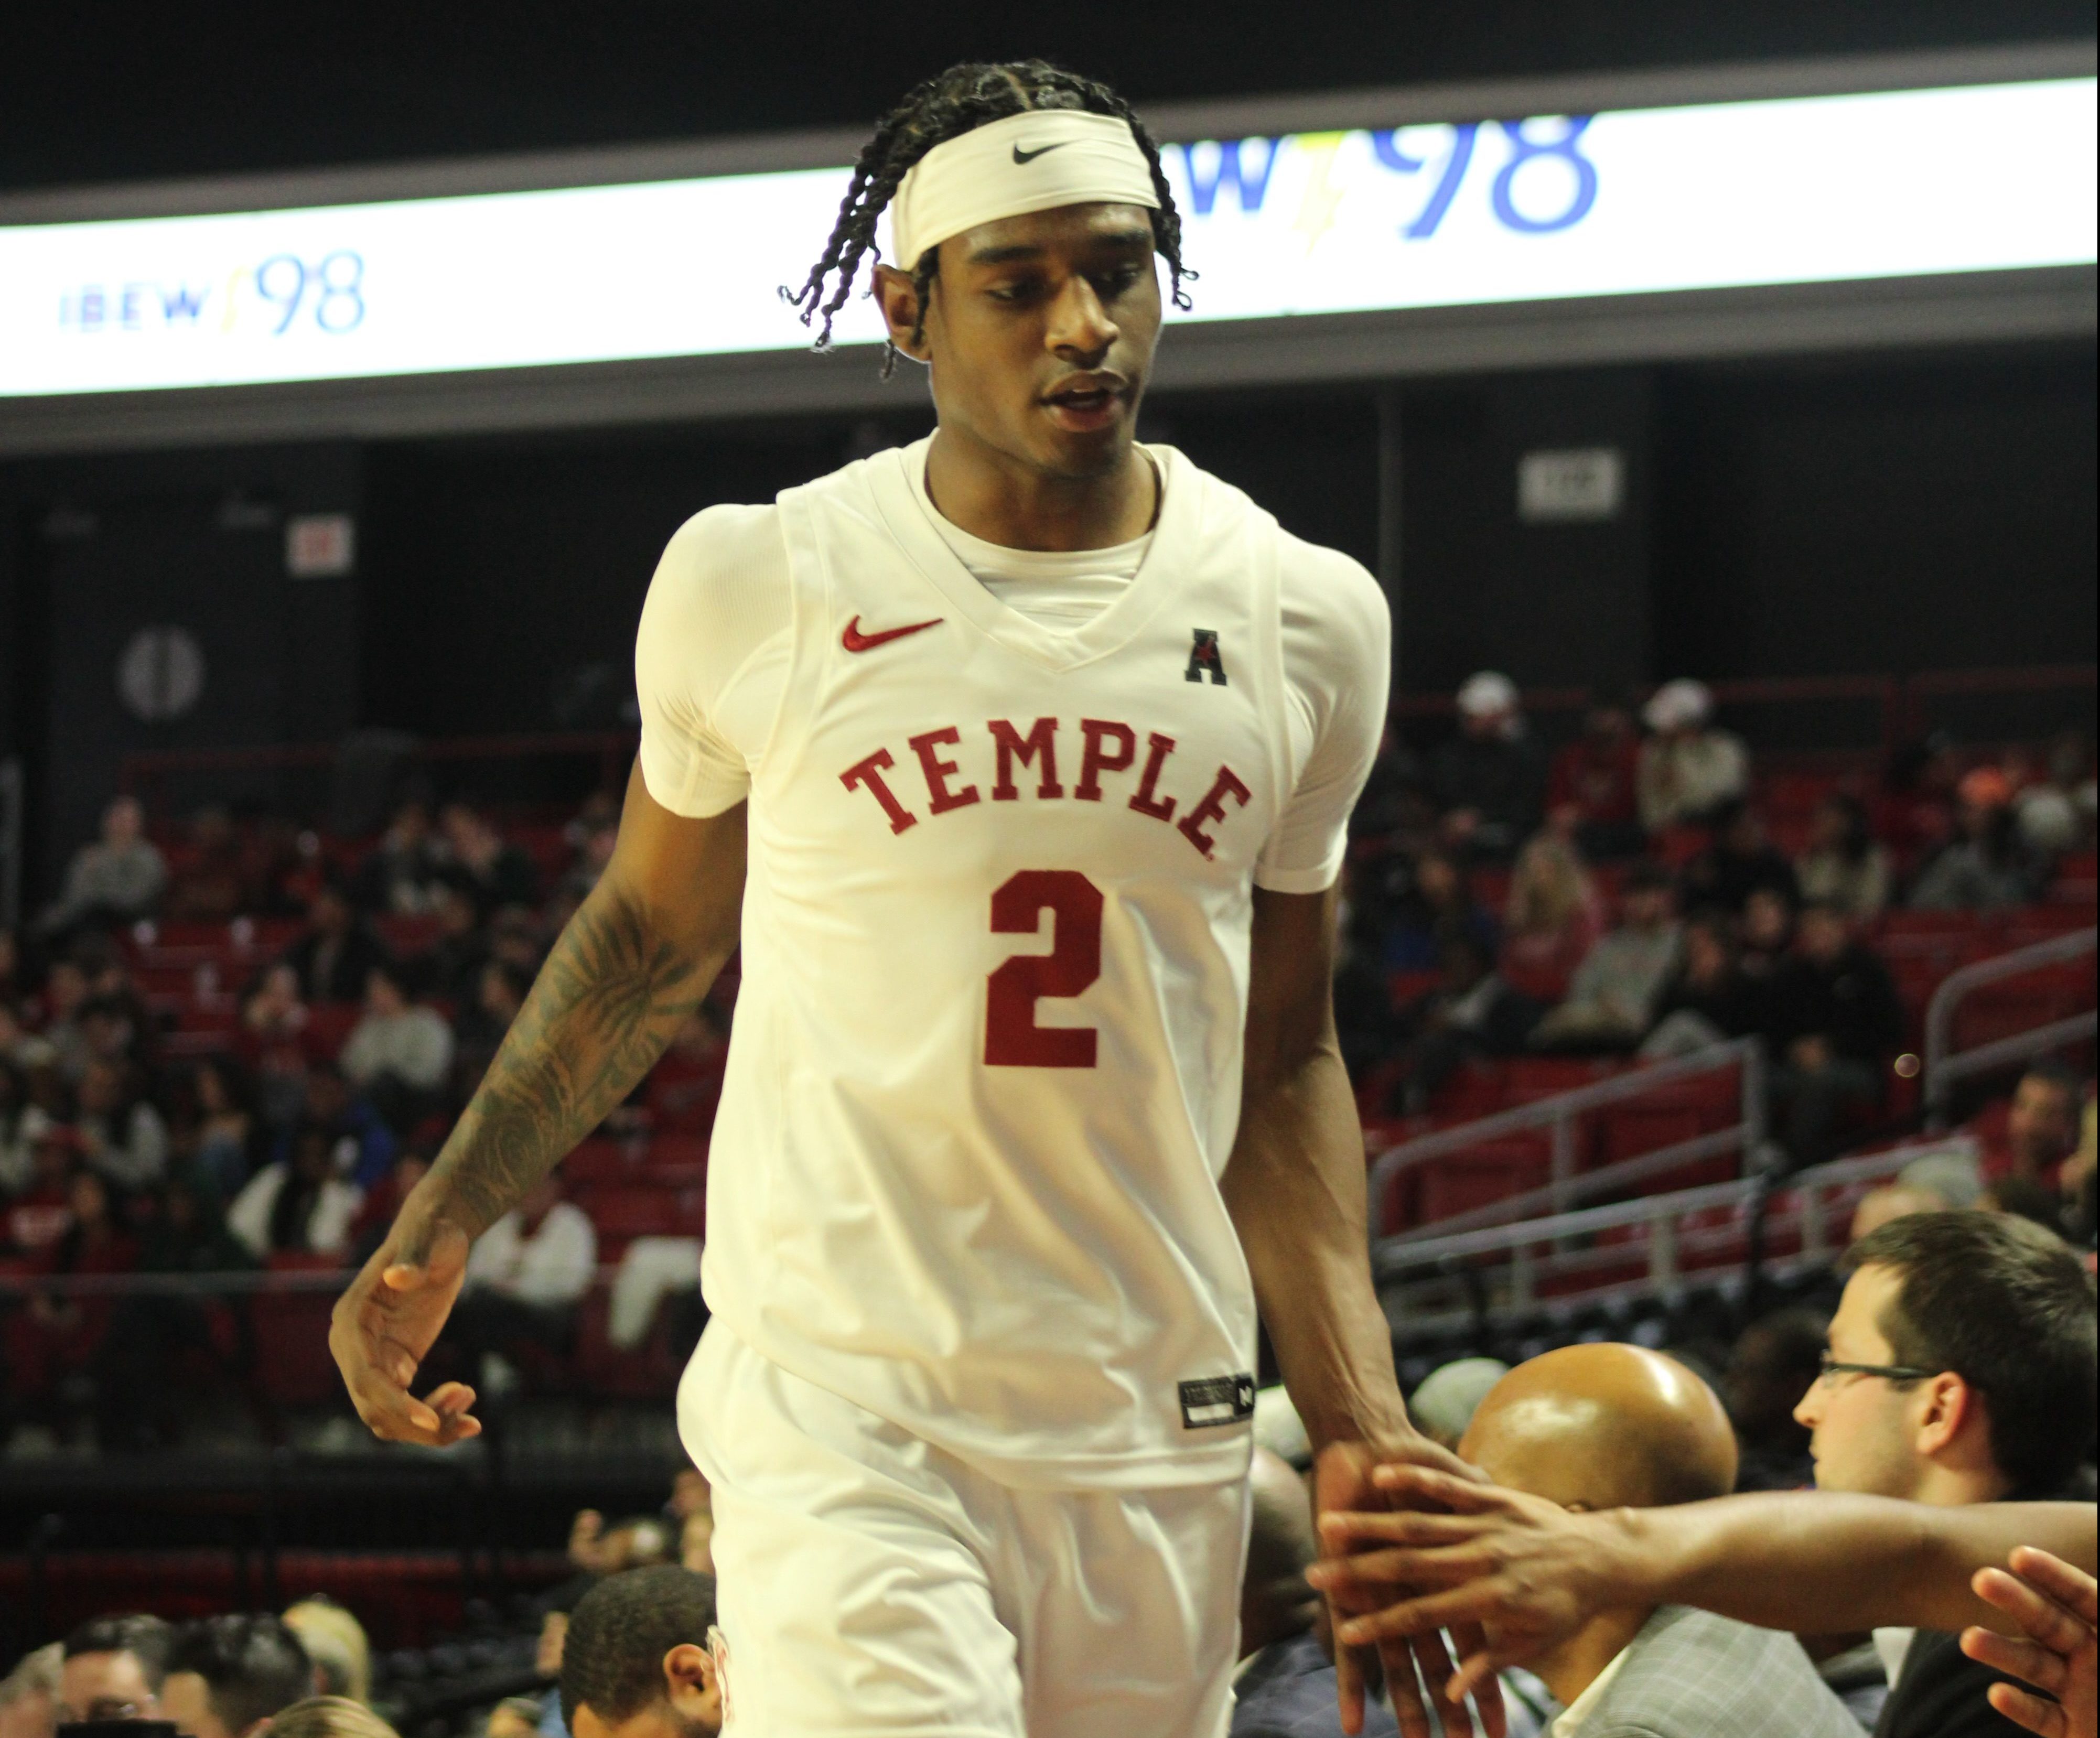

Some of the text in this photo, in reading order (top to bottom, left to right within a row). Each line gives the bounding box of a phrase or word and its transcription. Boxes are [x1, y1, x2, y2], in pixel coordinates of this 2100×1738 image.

[1370, 114, 1597, 241] 98
[59, 249, 365, 336] IBEW 98
[839, 717, 1253, 860] TEMPLE
[984, 870, 1104, 1068] 2
